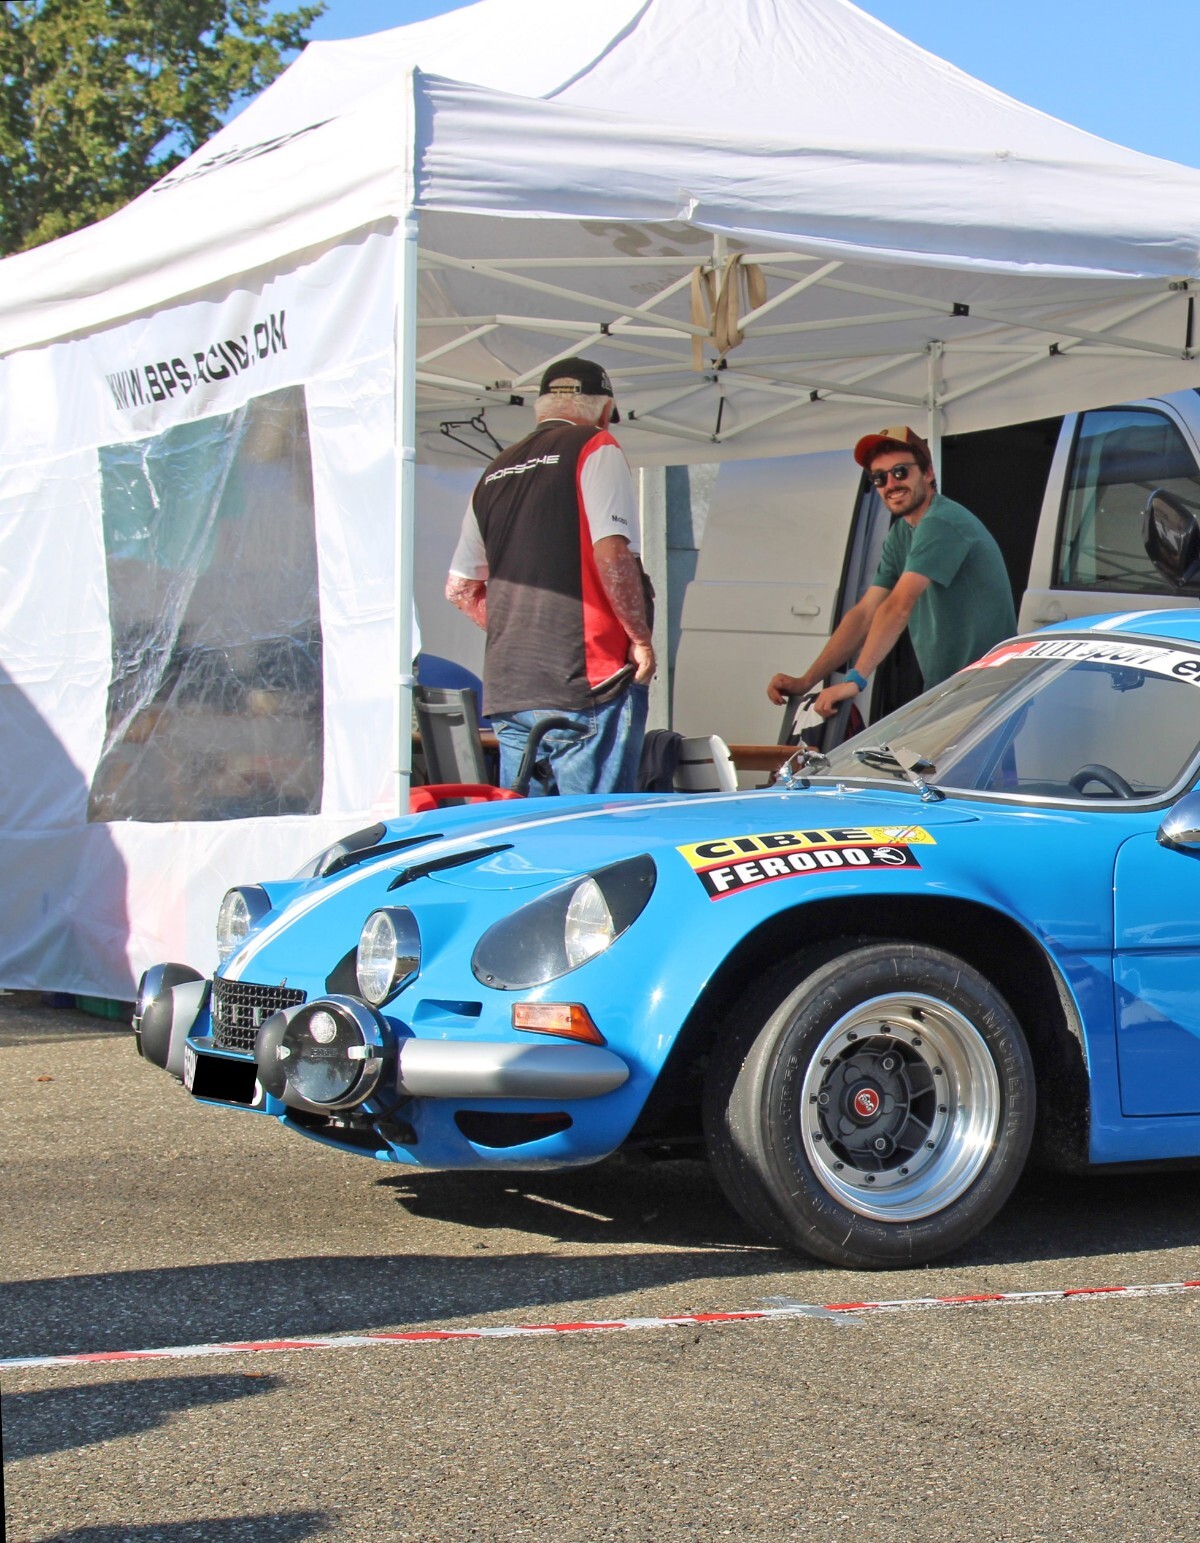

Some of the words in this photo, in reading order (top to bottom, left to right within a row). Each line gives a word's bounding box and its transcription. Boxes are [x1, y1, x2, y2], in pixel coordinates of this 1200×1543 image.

[484, 454, 561, 486] PORSCHE
[695, 827, 873, 859] CIBIE
[708, 848, 871, 893] FERODO
